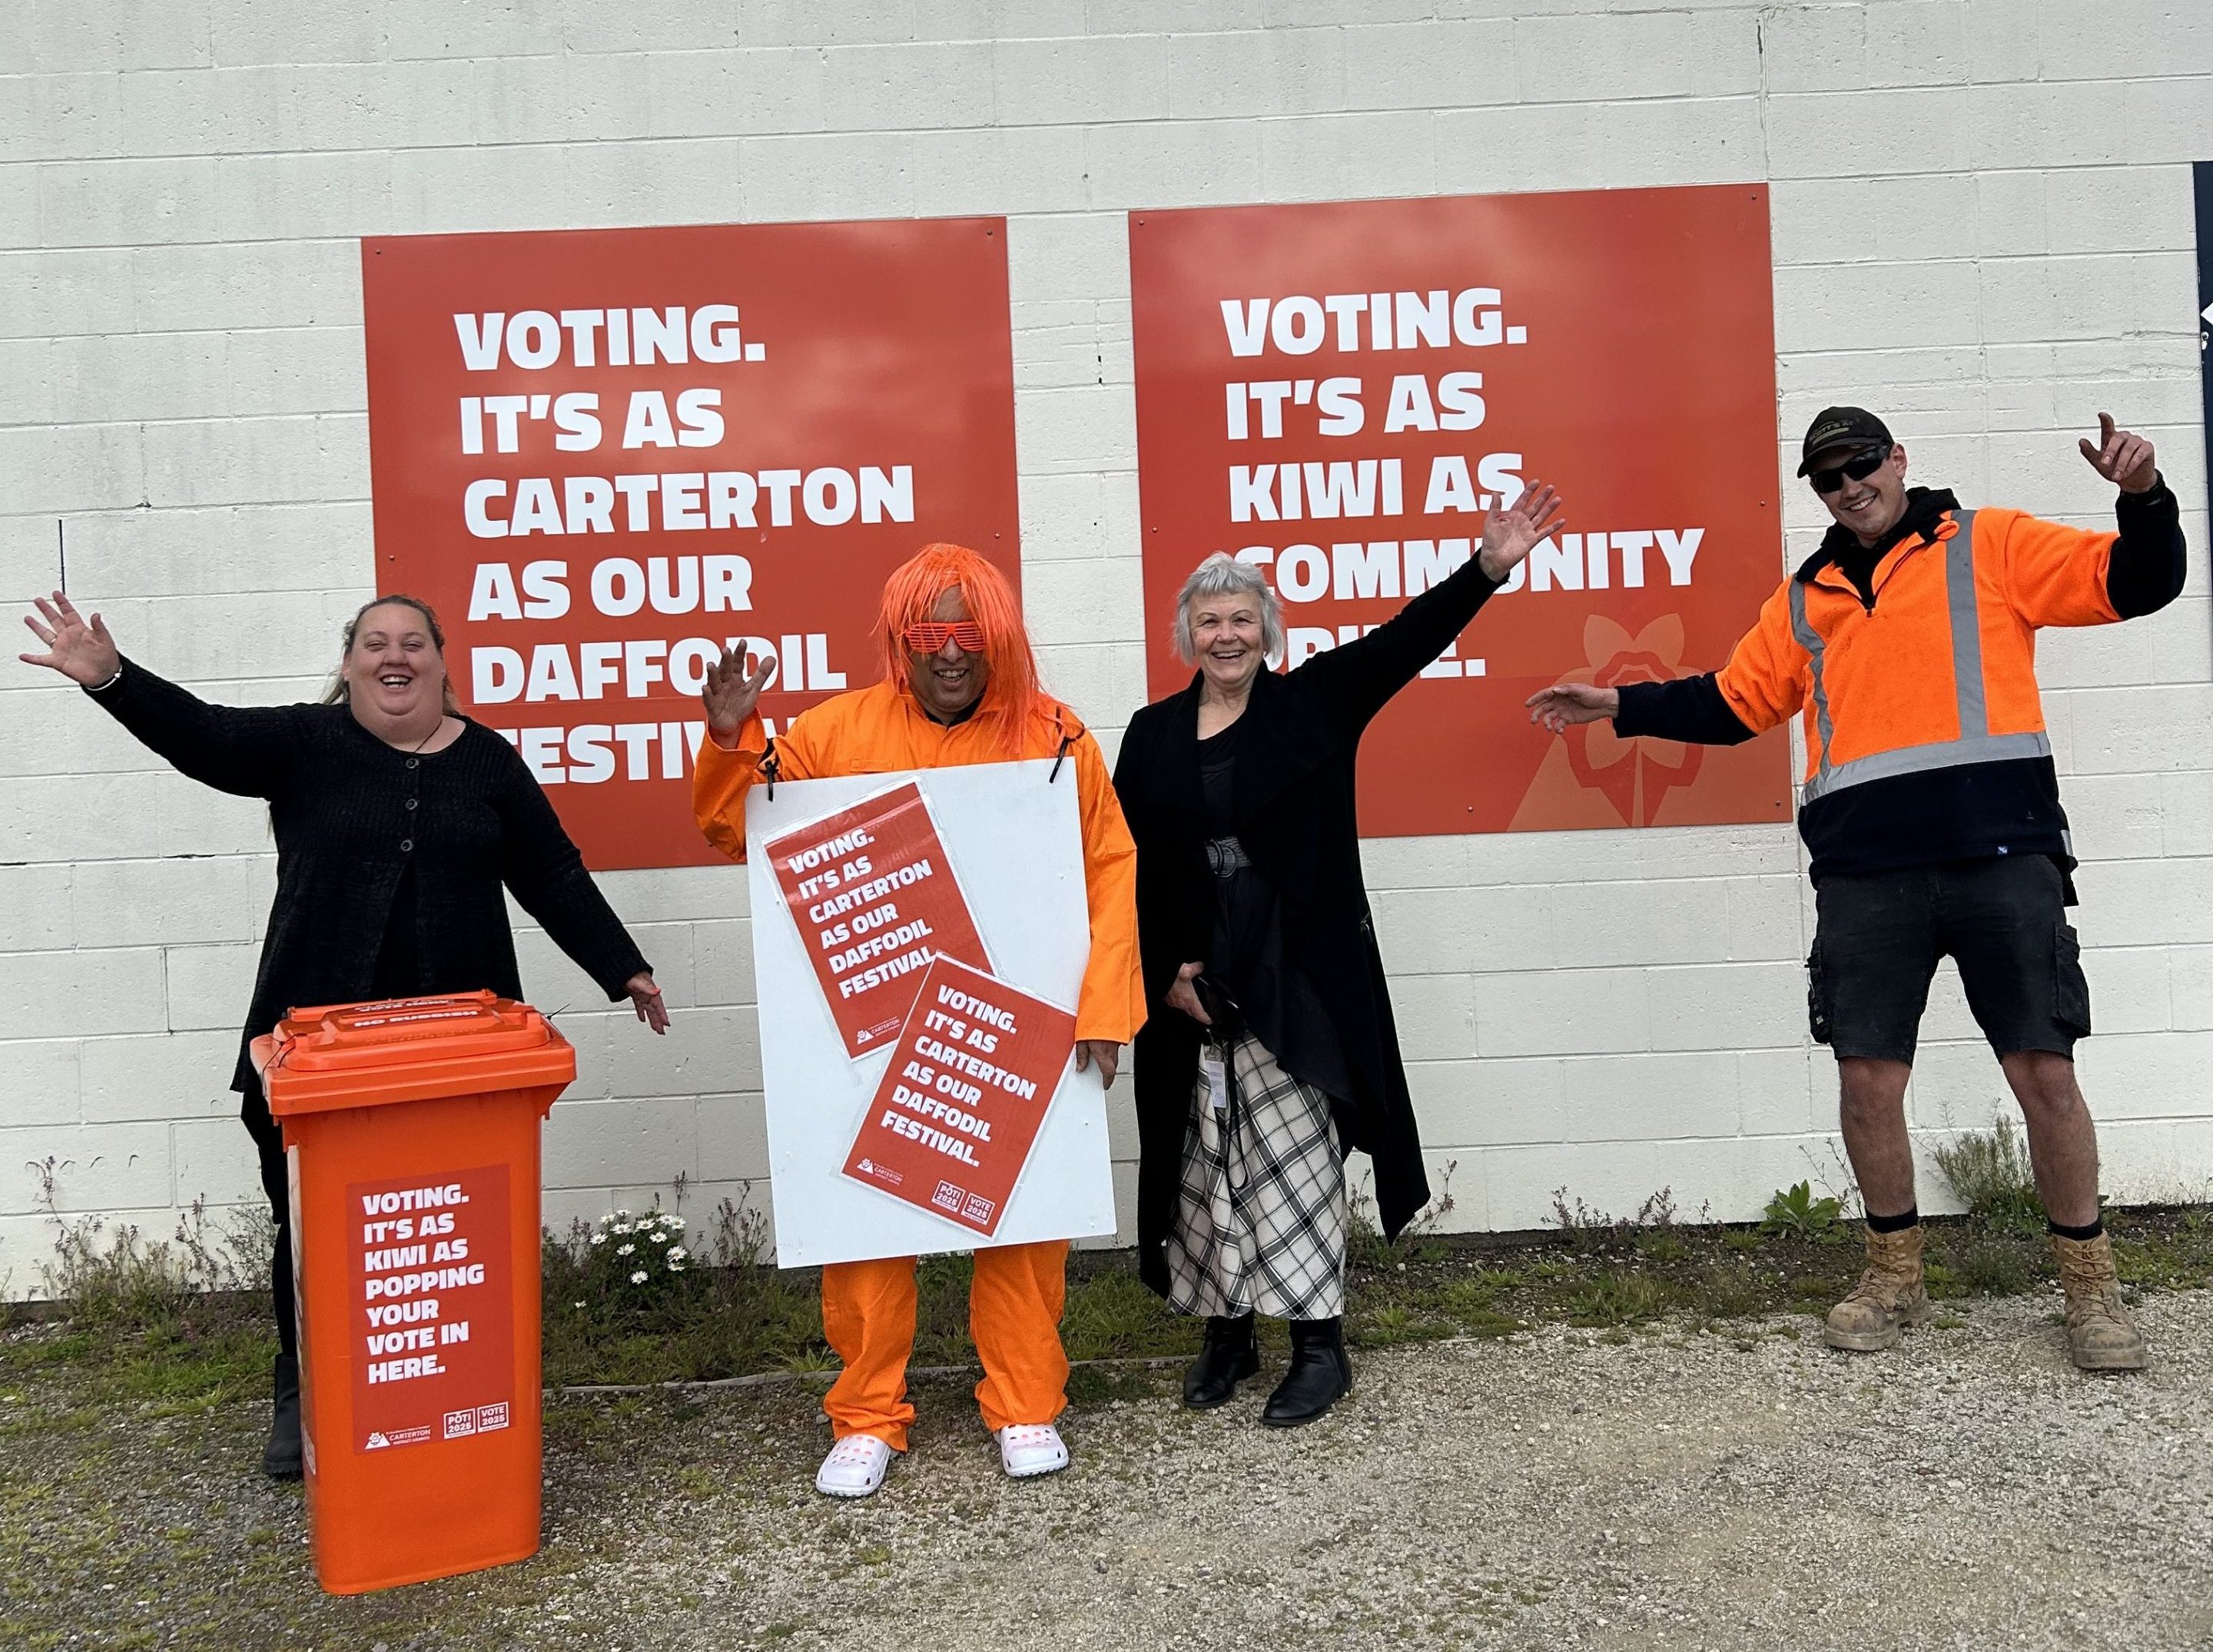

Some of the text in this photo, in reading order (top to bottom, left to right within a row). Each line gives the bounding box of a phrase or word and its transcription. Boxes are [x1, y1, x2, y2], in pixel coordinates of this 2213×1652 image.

[454, 304, 765, 370] VOTING.
[1220, 288, 1527, 357] VOTING.
[460, 389, 725, 454] IT'S AS
[1226, 372, 1485, 440] IT'S AS
[465, 466, 914, 538] CARTERTON
[1229, 453, 1525, 522] KIWI AS
[468, 555, 752, 621] AS OUR
[787, 828, 875, 874] VOTING.
[798, 856, 872, 900] IT'S AS
[810, 859, 932, 923] CARTERTON
[821, 904, 898, 949] AS OUR
[829, 919, 933, 974] DAFFODIL
[354, 1010, 479, 1028] NO RUBBISH
[938, 985, 1017, 1033] VOTING.
[924, 1010, 967, 1039] IT'S
[966, 1029, 998, 1053] AS
[902, 1061, 981, 1106] AS OUR
[915, 1036, 1037, 1100] CARTERTON
[892, 1085, 990, 1142] DAFFODIL
[881, 1110, 979, 1167] FESTIVAL.
[363, 1184, 469, 1215] VOTING.
[937, 1193, 957, 1206] 2025
[967, 1205, 988, 1219] 2025
[970, 1196, 991, 1211] VOTE
[364, 1213, 454, 1243] IT'S AS
[365, 1239, 467, 1272] KIWI AS
[366, 1264, 485, 1299] POPPING
[366, 1299, 439, 1327] YOUR
[367, 1322, 469, 1355] VOTE IN
[369, 1355, 446, 1384] HERE.
[448, 1421, 472, 1434] 2025
[481, 1405, 505, 1418] VOTE
[482, 1415, 506, 1426] 2025
[390, 1429, 430, 1441] CARTERTON
